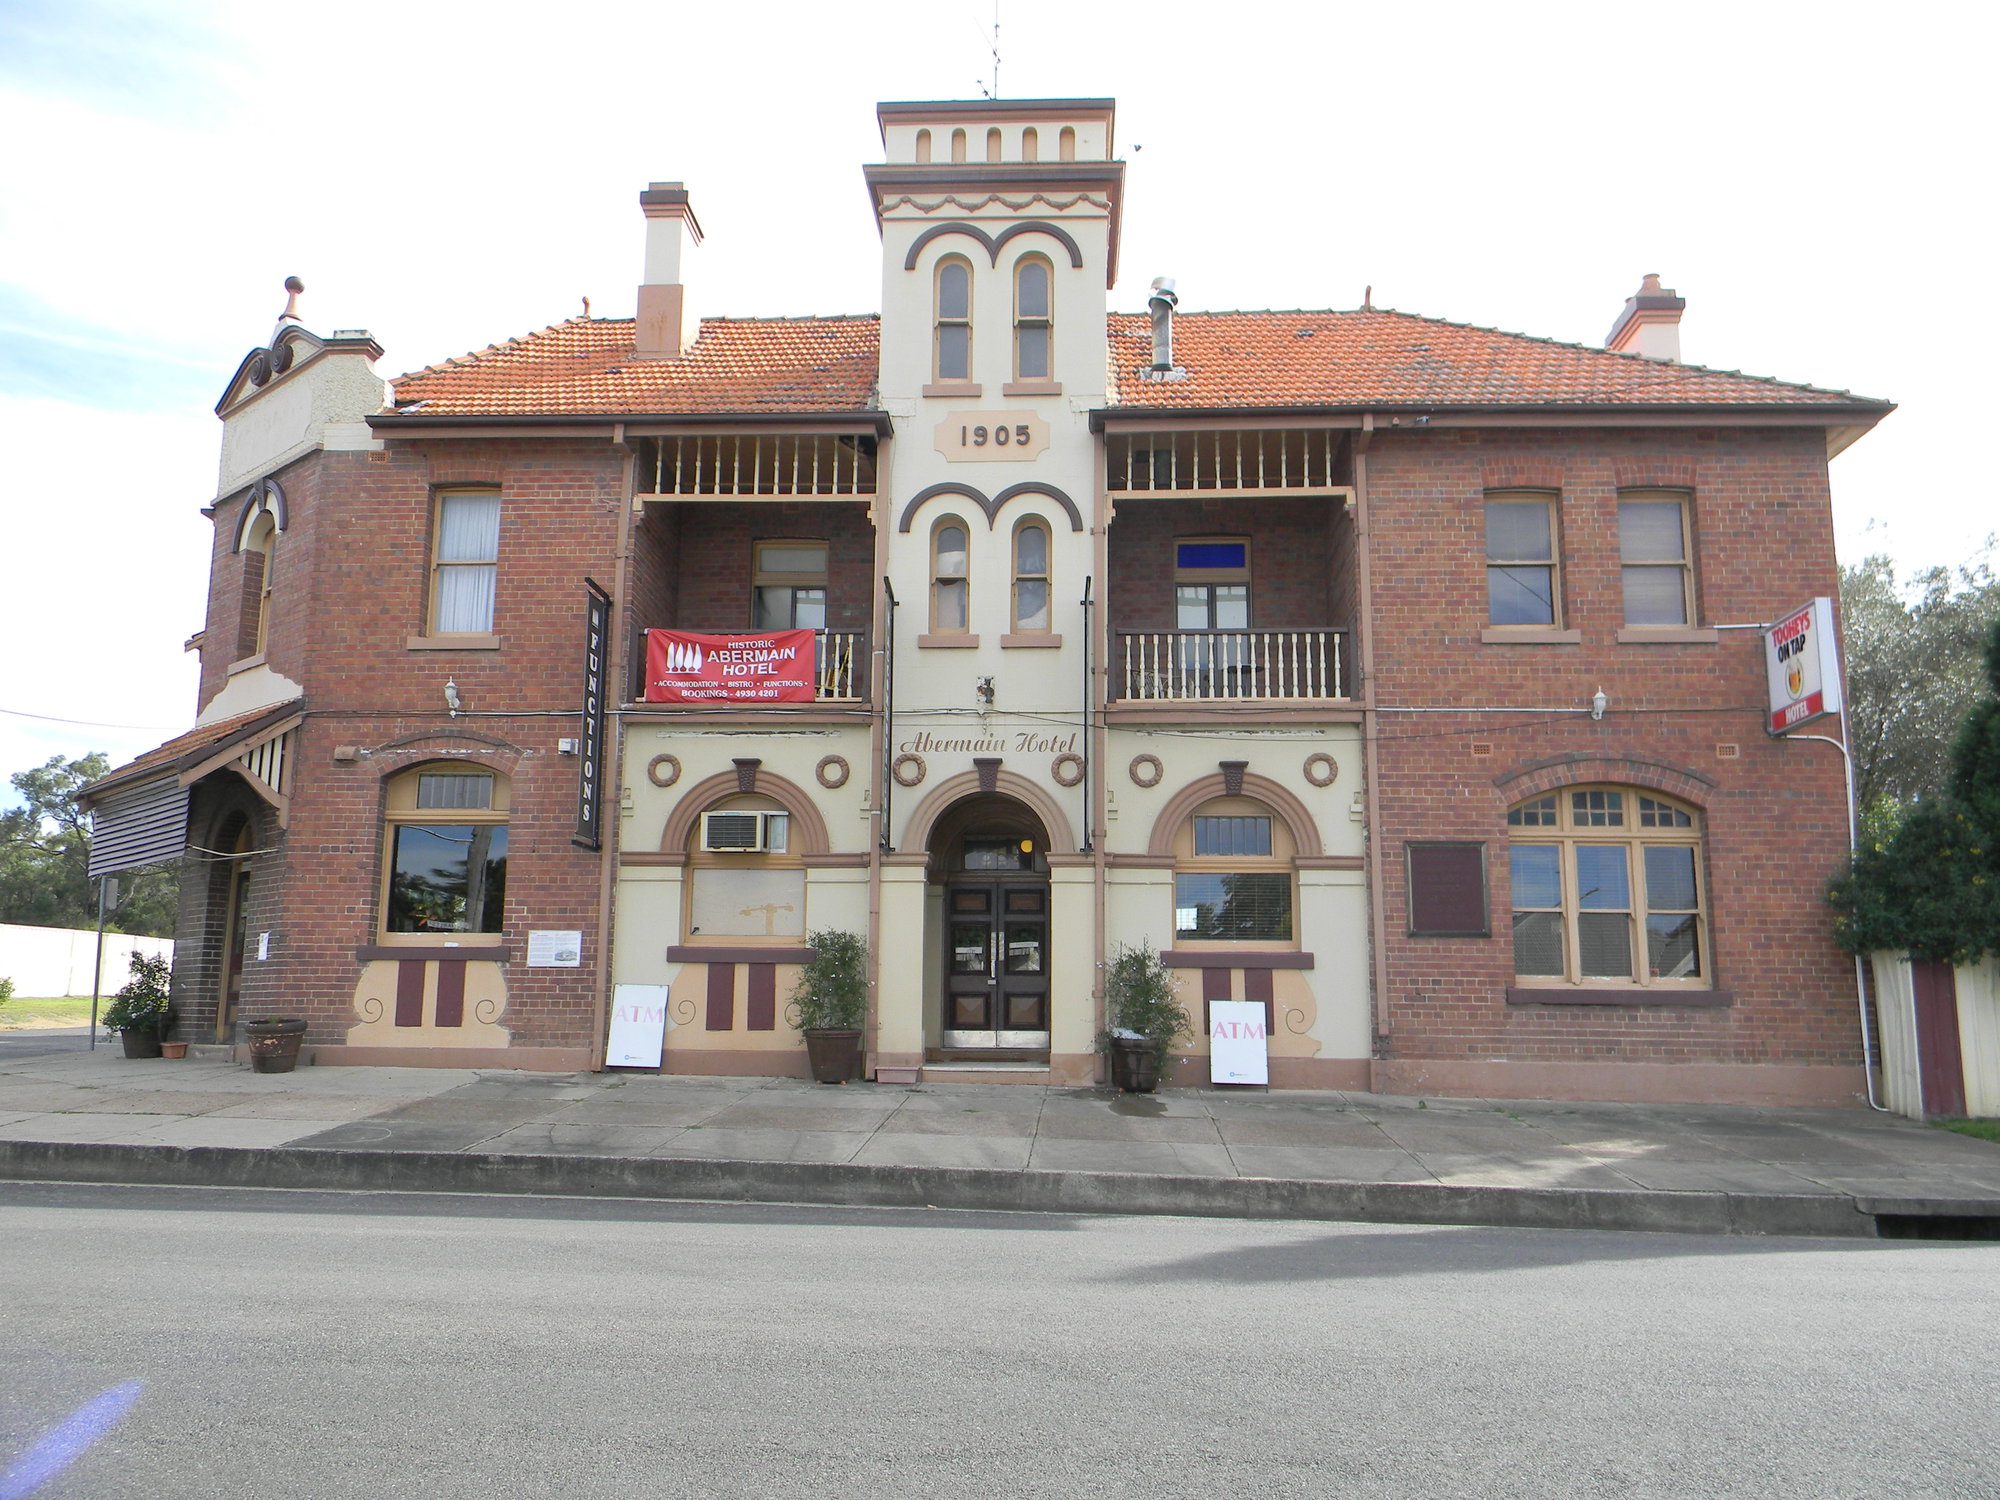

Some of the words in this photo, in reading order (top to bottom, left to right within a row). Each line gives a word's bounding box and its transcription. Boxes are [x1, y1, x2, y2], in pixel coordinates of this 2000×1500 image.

[962, 425, 1030, 446] 1905
[1772, 611, 1810, 648] TOOHEYS
[728, 640, 775, 649] HISTORIC
[1777, 642, 1790, 663] ON
[1790, 634, 1806, 656] TAP
[707, 647, 795, 663] ABERMAIN
[722, 663, 778, 676] HOTEL
[658, 680, 718, 688] ACCOMMODATION
[681, 690, 728, 698] BOOKINGS
[758, 689, 778, 698] 4201
[1785, 701, 1809, 725] HOTEL
[582, 632, 599, 822] FUNCTIONS
[900, 731, 1006, 753] Abermain
[1015, 732, 1077, 753] Hotel
[613, 1005, 663, 1023] ATM
[1212, 1021, 1265, 1040] ATM
